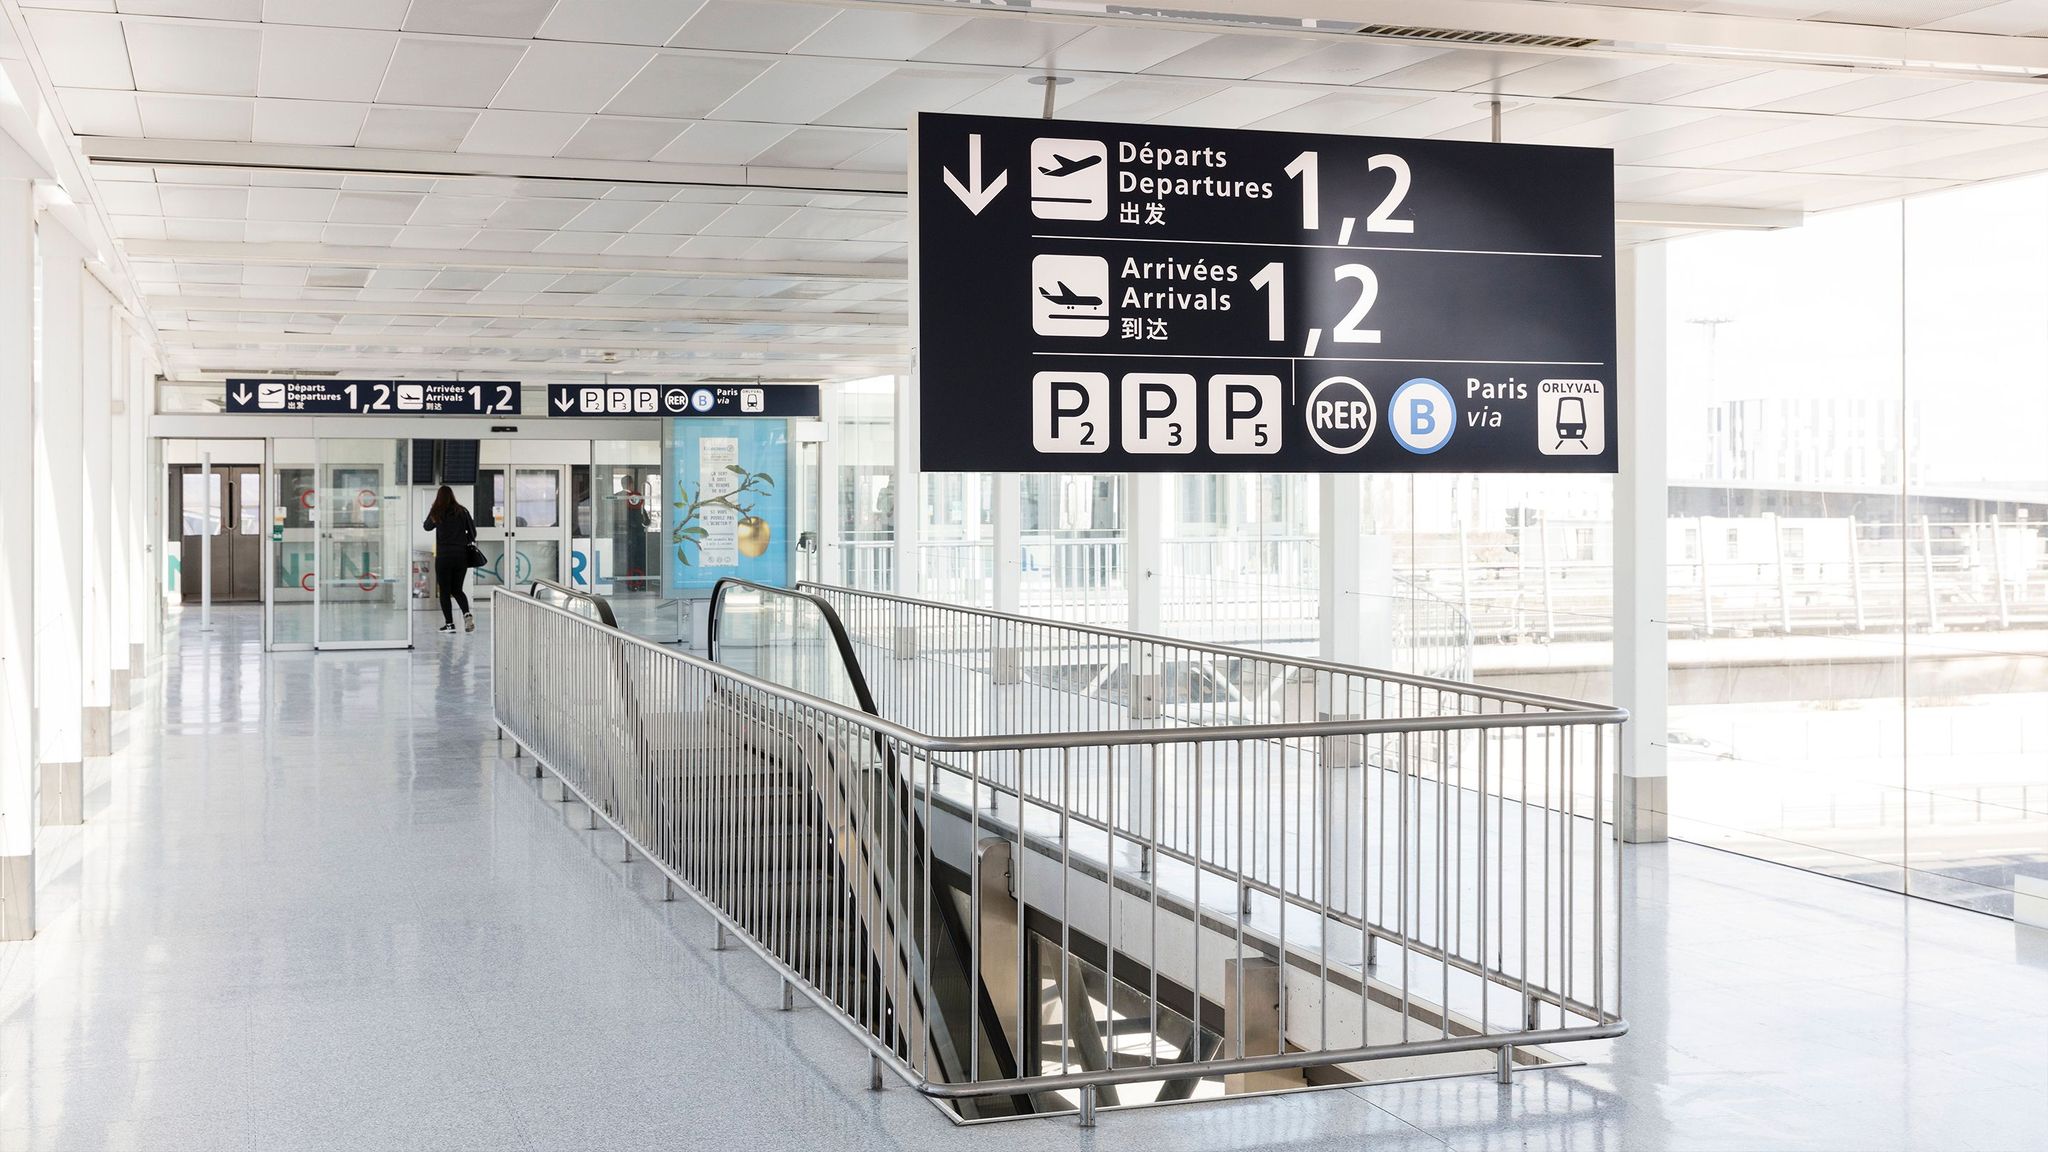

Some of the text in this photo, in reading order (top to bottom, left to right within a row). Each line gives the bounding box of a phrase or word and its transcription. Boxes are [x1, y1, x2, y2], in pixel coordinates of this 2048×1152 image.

[1119, 141, 1227, 170] Départs
[1119, 171, 1274, 200] Departures
[1284, 150, 1415, 246] 1,2
[1119, 202, 1167, 226] 出发
[1120, 256, 1239, 282] Arrivées
[1120, 286, 1232, 311] Arrivals
[1249, 262, 1382, 357] 1,2
[1120, 316, 1169, 340] 到达
[287, 383, 326, 393] Départs
[287, 392, 342, 402] Departures
[425, 385, 465, 393] Arrivées
[425, 394, 463, 402] Arrivals
[716, 388, 738, 396] Paris
[1466, 377, 1528, 400] Paris
[1542, 382, 1600, 394] ORLYVAL
[668, 396, 686, 406] RER
[698, 396, 707, 406] B
[716, 396, 730, 404] via
[1316, 400, 1368, 430] RER
[1410, 398, 1436, 435] B
[1467, 405, 1502, 428] via
